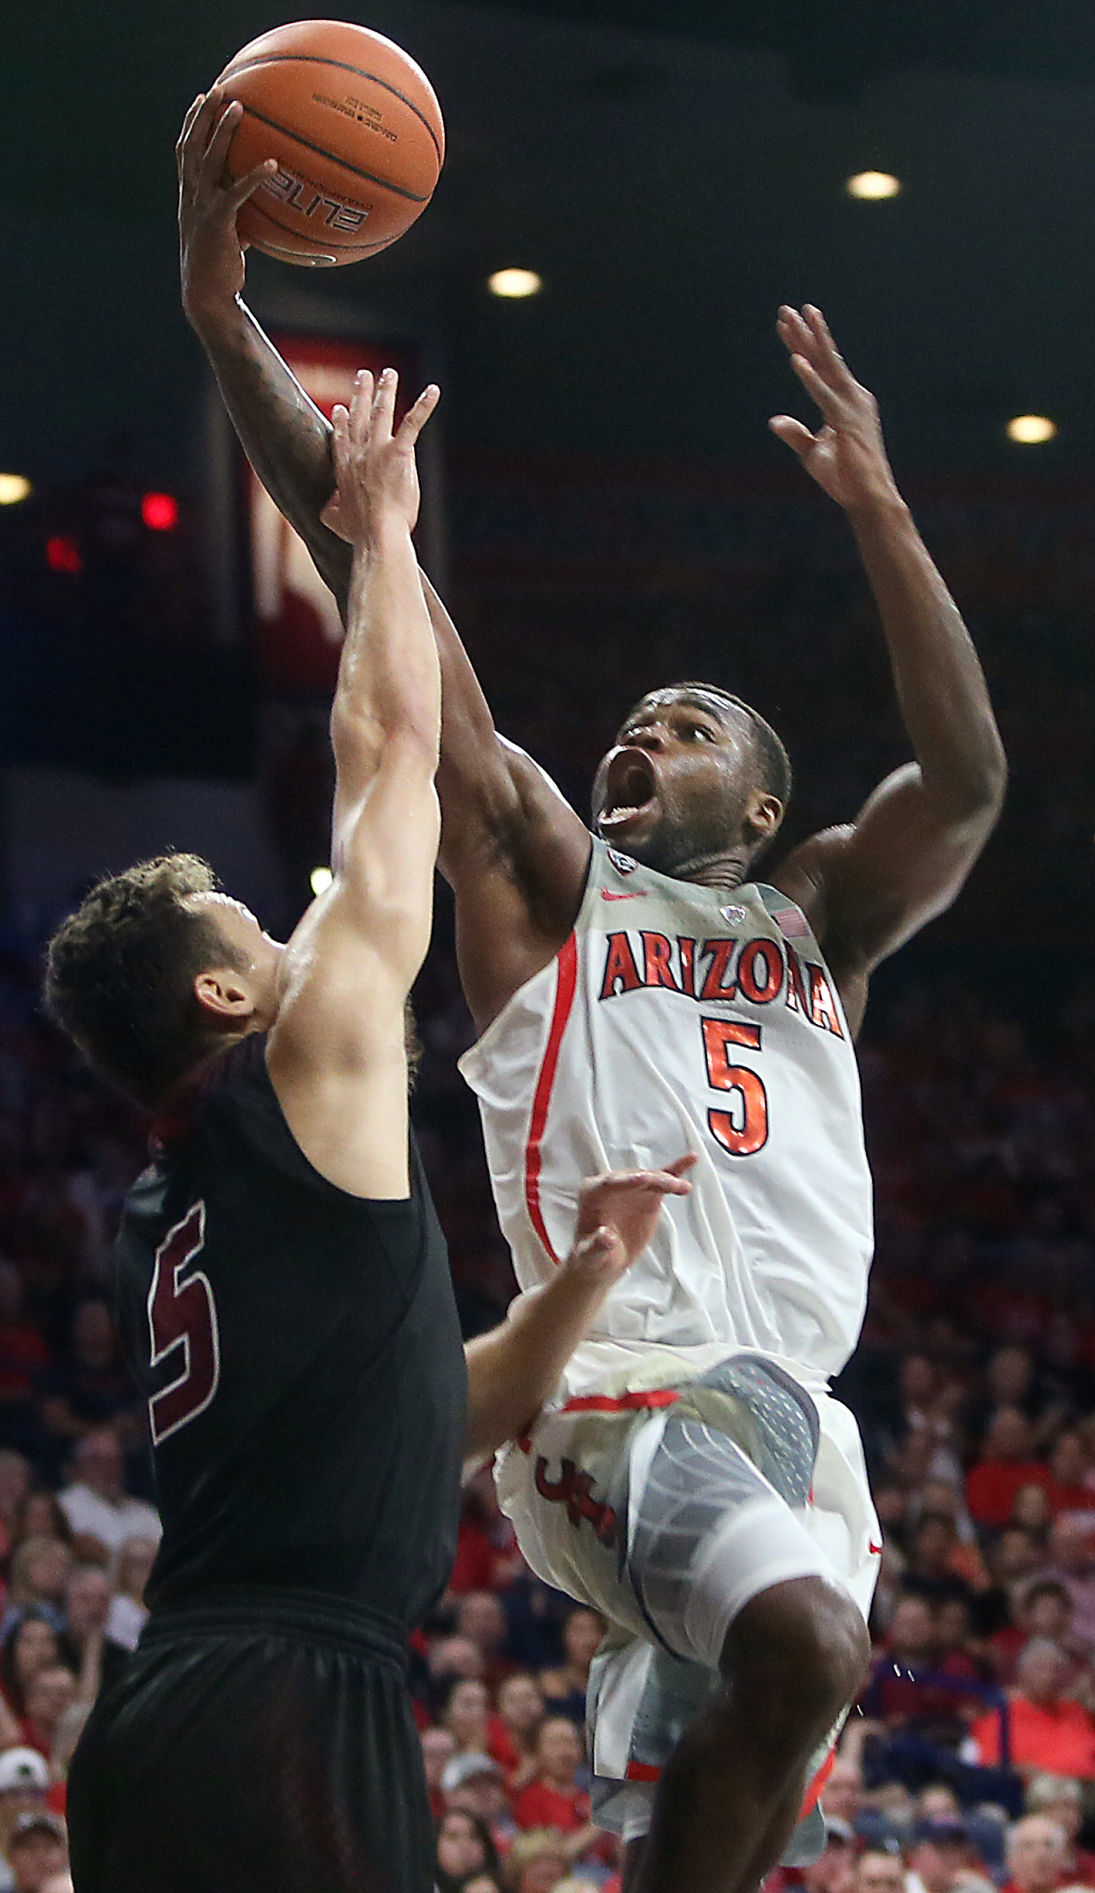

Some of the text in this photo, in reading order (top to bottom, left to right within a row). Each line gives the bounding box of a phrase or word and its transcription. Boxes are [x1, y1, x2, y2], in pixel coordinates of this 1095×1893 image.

[261, 168, 369, 234] ELITE
[598, 931, 845, 1041] ARIZONA
[700, 1016, 769, 1157] 5
[147, 1198, 221, 1447] 5
